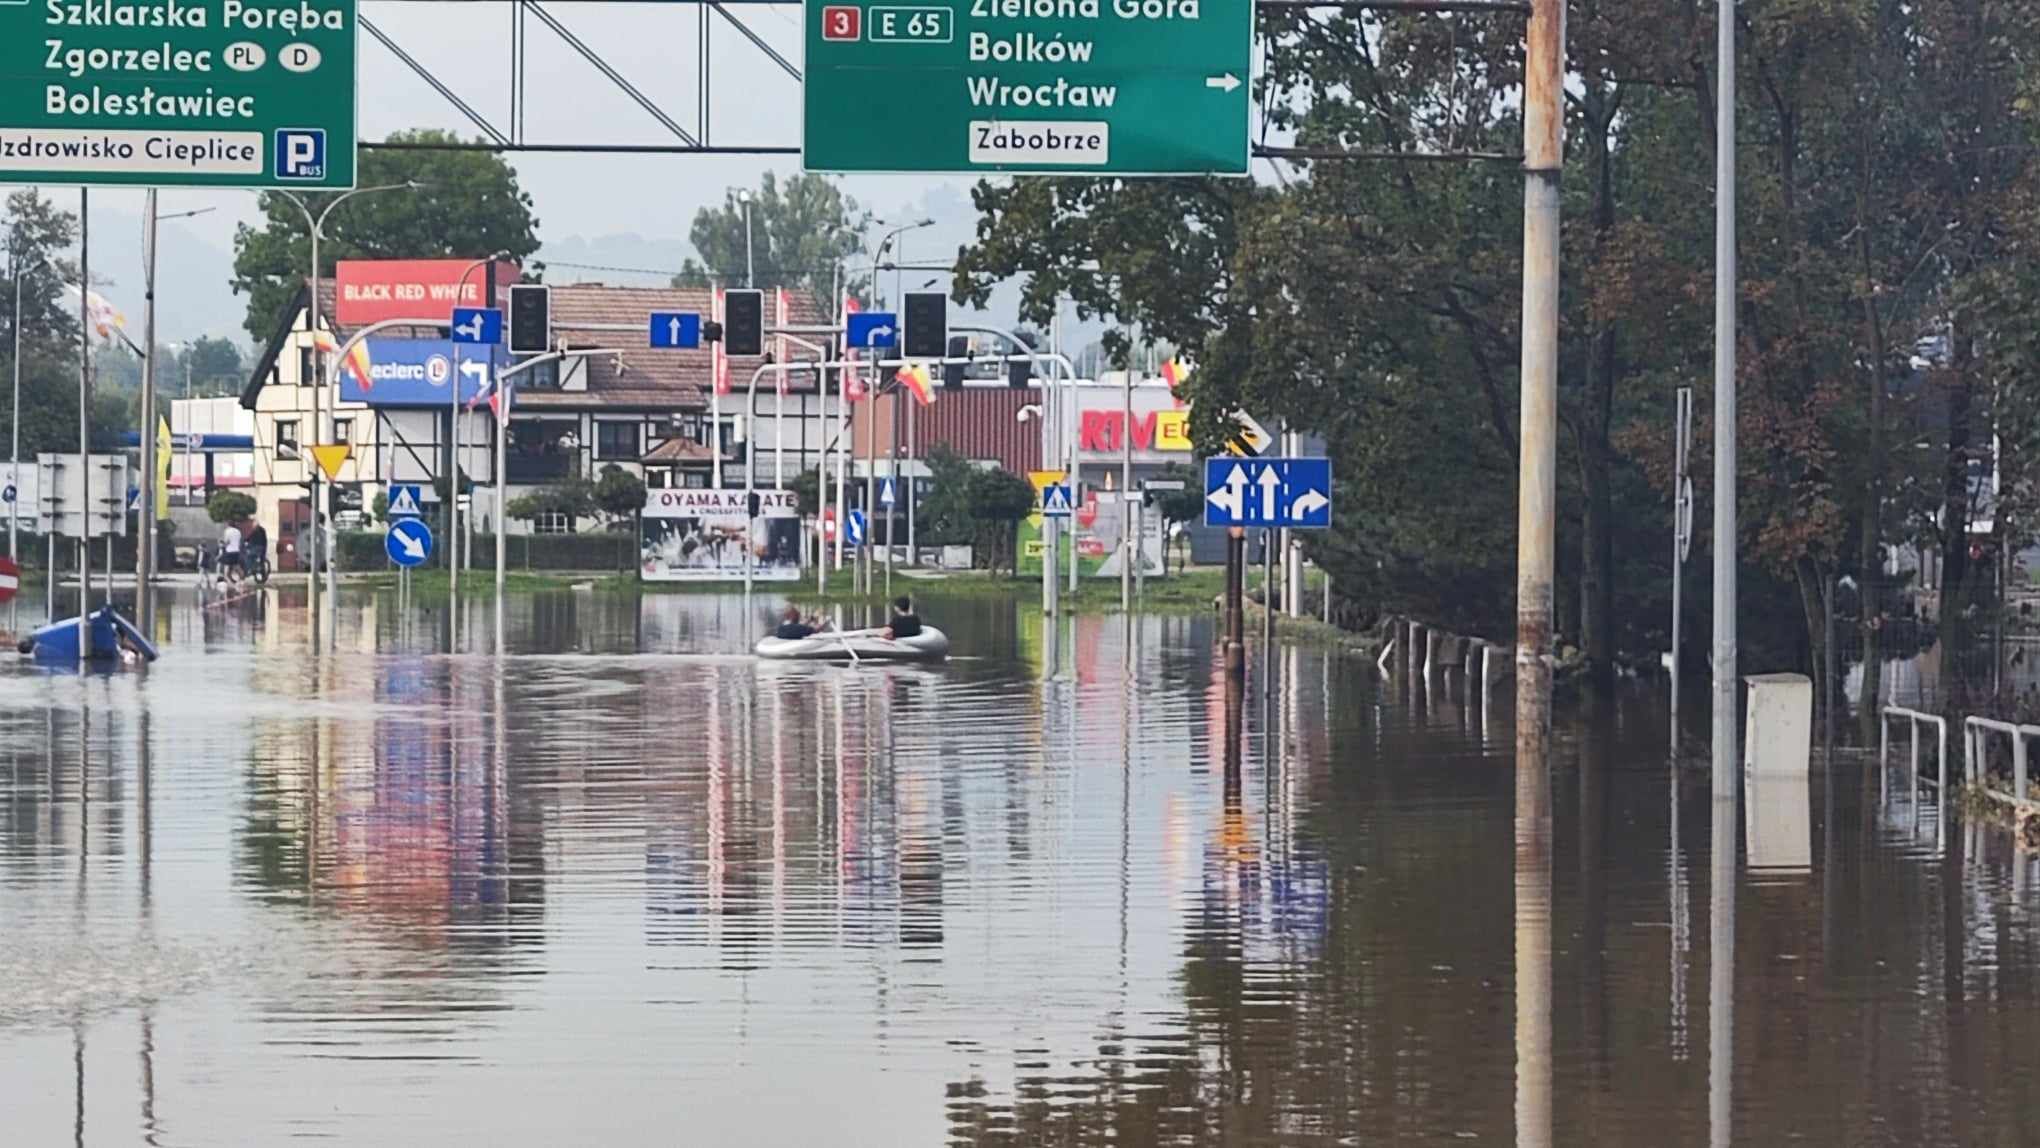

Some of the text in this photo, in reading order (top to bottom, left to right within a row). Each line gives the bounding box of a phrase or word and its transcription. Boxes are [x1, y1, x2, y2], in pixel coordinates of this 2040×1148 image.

[46, 0, 343, 36] Szklarska Poręba
[834, 13, 849, 34] 3
[882, 13, 940, 37] E 65
[44, 40, 308, 77] Zgorzelec PL D
[970, 32, 1092, 62] Bolków
[46, 85, 255, 118] Bolesławiec
[967, 77, 1117, 108] Wrocław
[0, 135, 255, 166] zdrowisko Cieplice
[288, 135, 315, 173] P
[977, 127, 1101, 151] Zabobrze
[299, 165, 322, 176] BUS
[344, 284, 478, 300] BLACK RED WHITE
[1081, 411, 1158, 452] RTV
[661, 493, 796, 508] OYAMA KAATE
